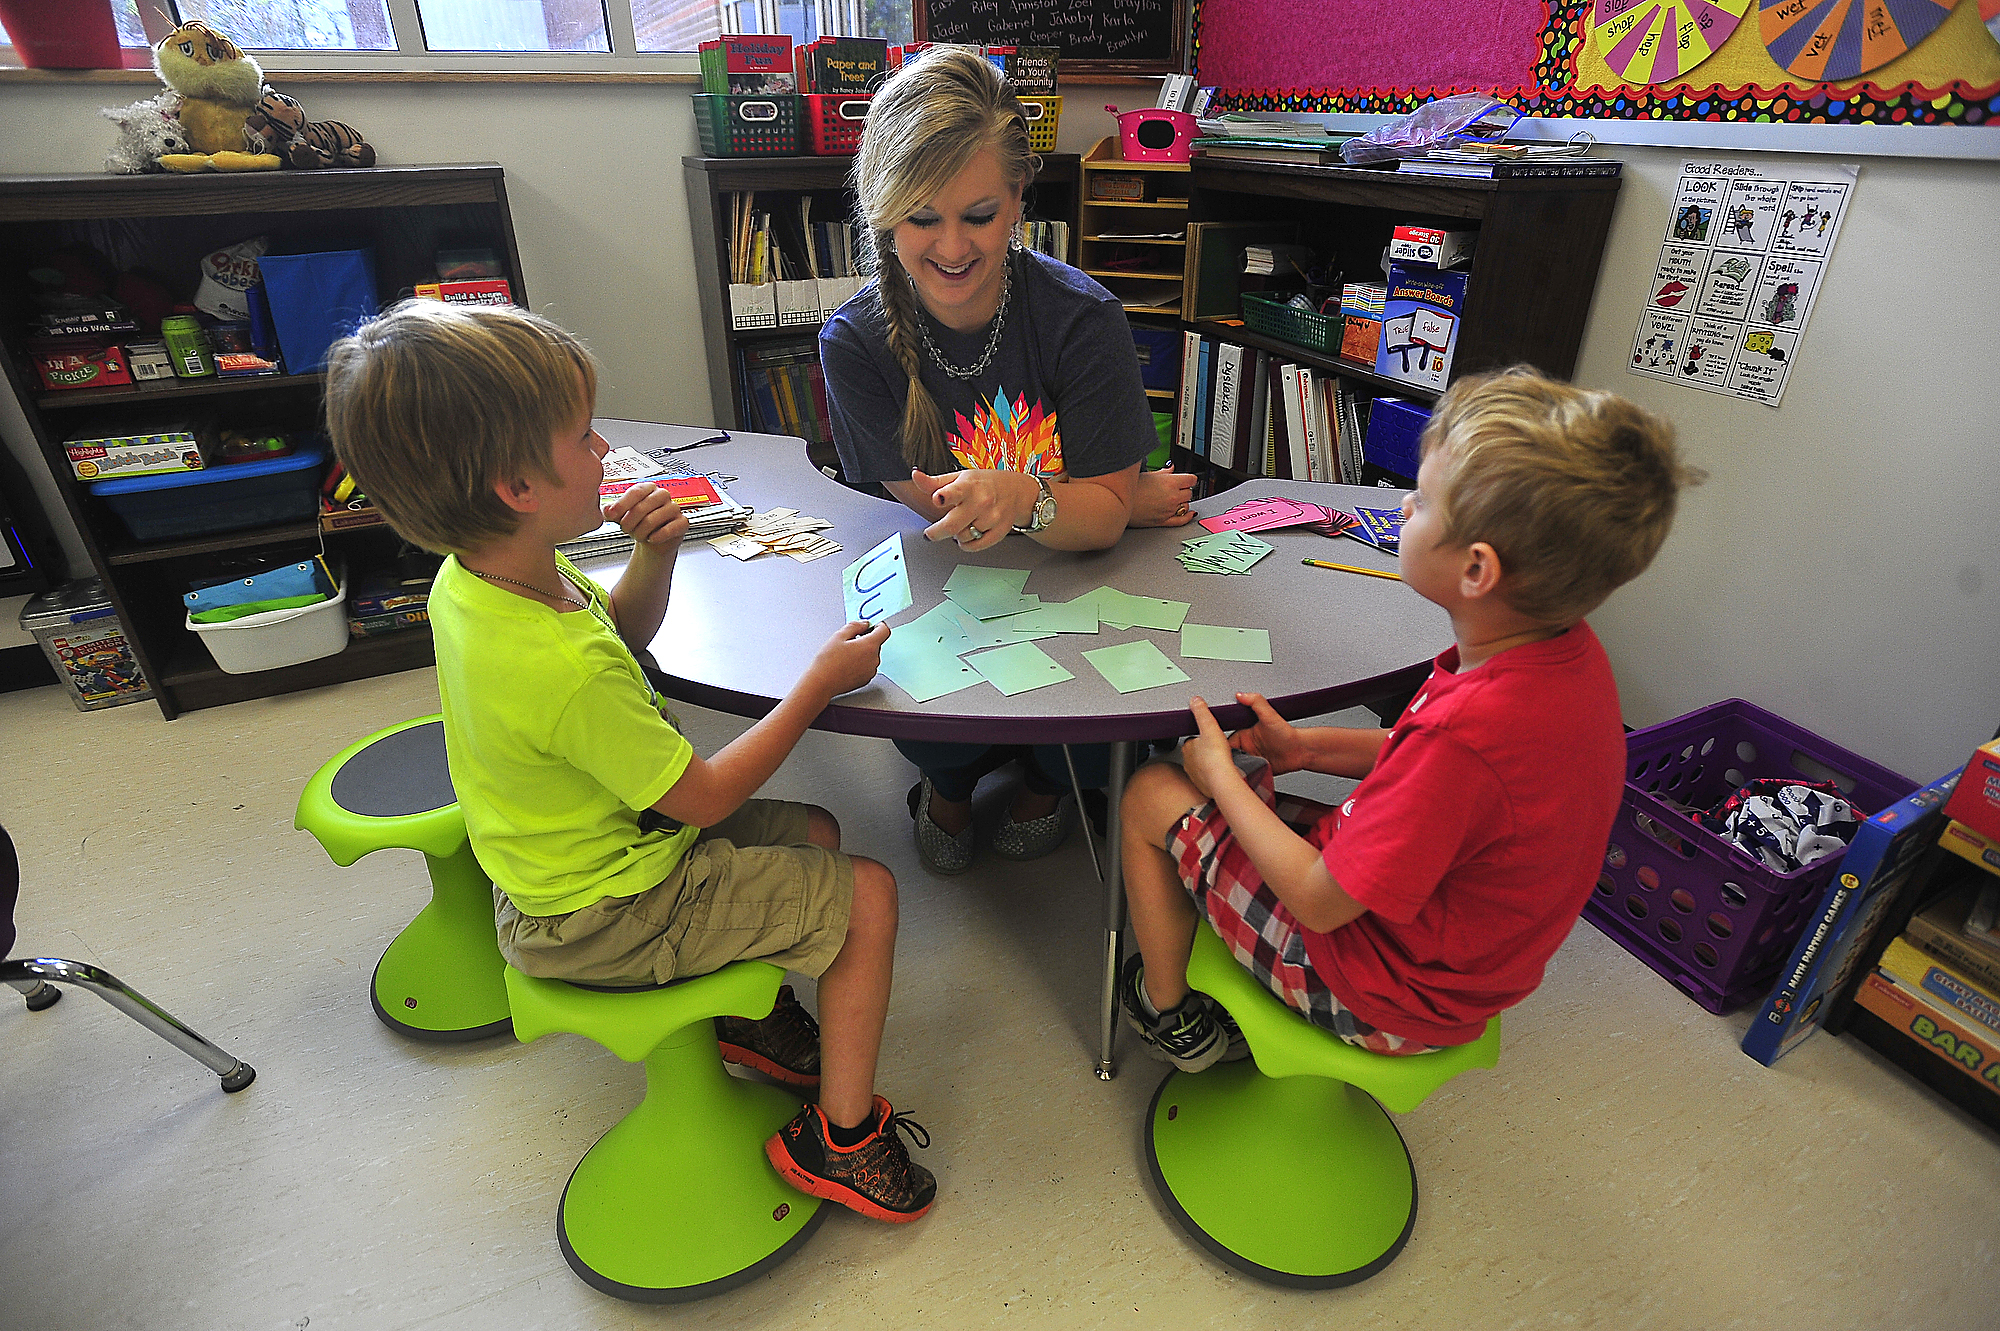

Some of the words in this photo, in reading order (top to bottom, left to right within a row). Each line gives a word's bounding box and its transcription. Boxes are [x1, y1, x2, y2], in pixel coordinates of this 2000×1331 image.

[932, 23, 969, 40] Jaden
[1049, 11, 1094, 31] Jakoby
[1102, 13, 1135, 27] Karla
[1607, 14, 1635, 38] shop
[1030, 30, 1064, 43] Cooper
[1069, 31, 1103, 46] Brady
[729, 43, 785, 56] Holiday
[744, 55, 772, 66] Fun
[826, 57, 856, 70] Paper
[858, 59, 877, 71] and
[1016, 57, 1048, 67] Friends
[839, 70, 865, 82] Trees
[1017, 68, 1026, 76] in
[1027, 68, 1046, 77] Your
[1008, 77, 1054, 88] Community
[1685, 163, 1712, 175] Good
[1684, 181, 1717, 193] LOOK
[1394, 246, 1417, 258] Slider
[1768, 261, 1794, 274] Spell
[443, 291, 467, 301] Build
[477, 290, 503, 299] Learn
[1393, 285, 1425, 300] Answer
[1425, 289, 1454, 307] Boards
[66, 326, 89, 334] DINO
[90, 325, 111, 333] WAR
[46, 360, 65, 370] IN
[69, 355, 82, 366] A
[1431, 359, 1444, 372] 10
[50, 366, 93, 381] PICKLE
[1221, 361, 1235, 414] Dyslexia
[1223, 517, 1237, 525] to
[1239, 511, 1267, 522] want
[78, 637, 120, 651] LIMITED
[80, 641, 124, 656] EDITION
[1788, 962, 1808, 989] MATH
[1801, 922, 1829, 964] PARTNER
[1823, 889, 1848, 923] GAMES
[1933, 973, 1973, 999] GIANT
[1911, 1015, 1983, 1070] BAR
